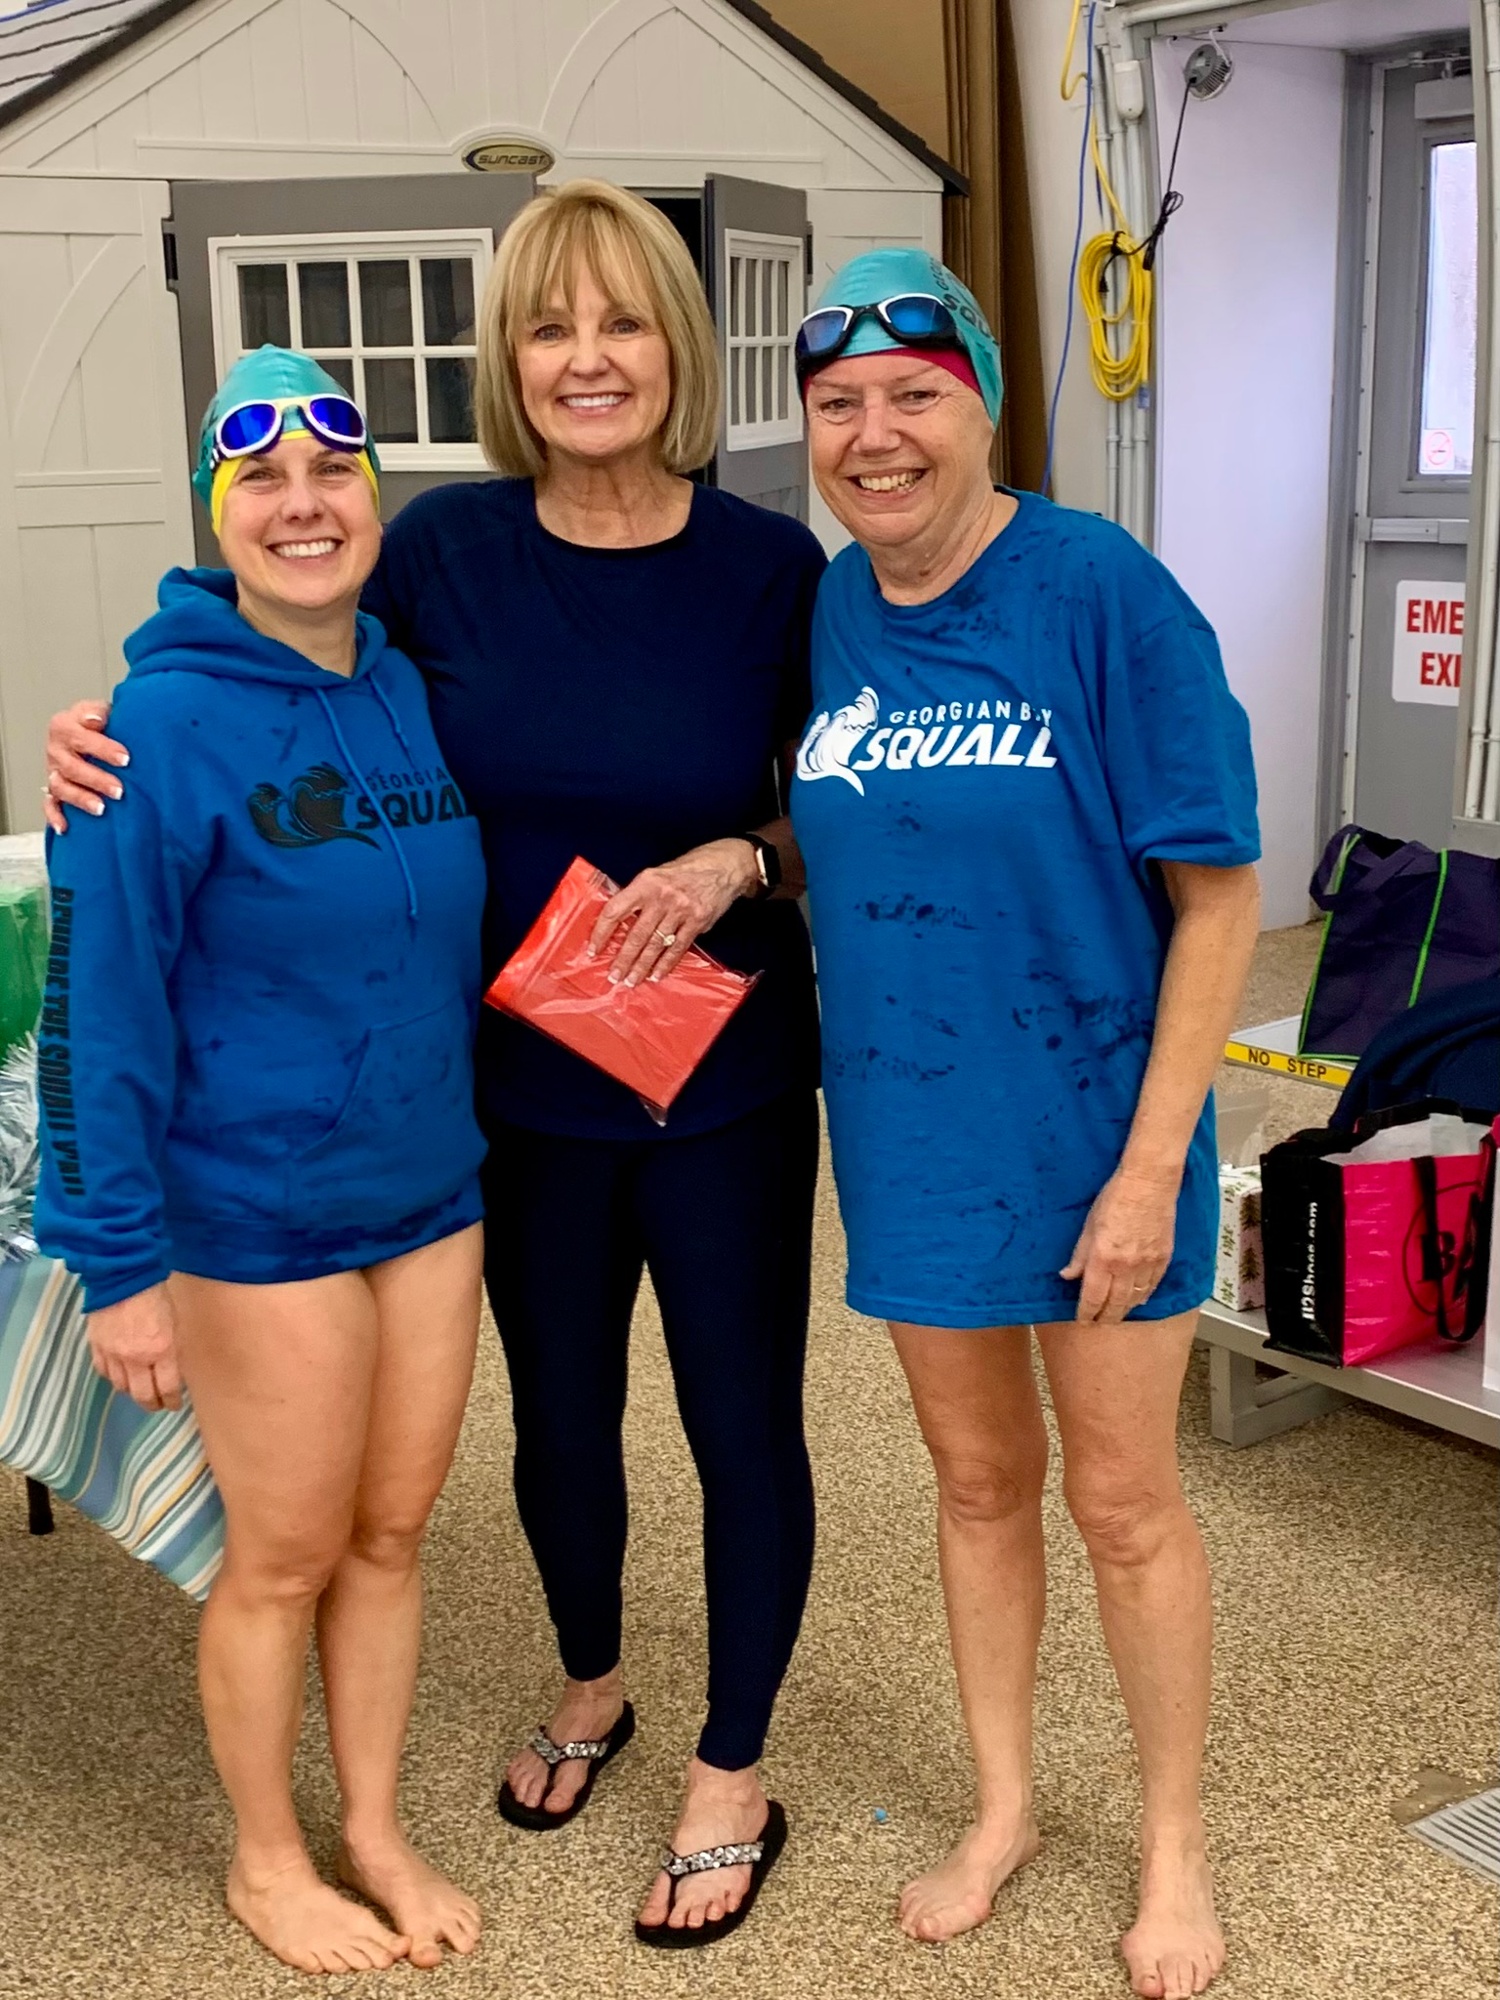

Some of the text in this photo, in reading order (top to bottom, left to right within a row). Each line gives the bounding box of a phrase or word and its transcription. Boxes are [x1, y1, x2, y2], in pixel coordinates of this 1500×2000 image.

[1407, 599, 1465, 635] EME
[889, 700, 1011, 726] GEORGIAN
[852, 723, 1058, 770] SQUALL
[40, 994, 70, 1039] THE
[1248, 1048, 1327, 1079] NO STEP
